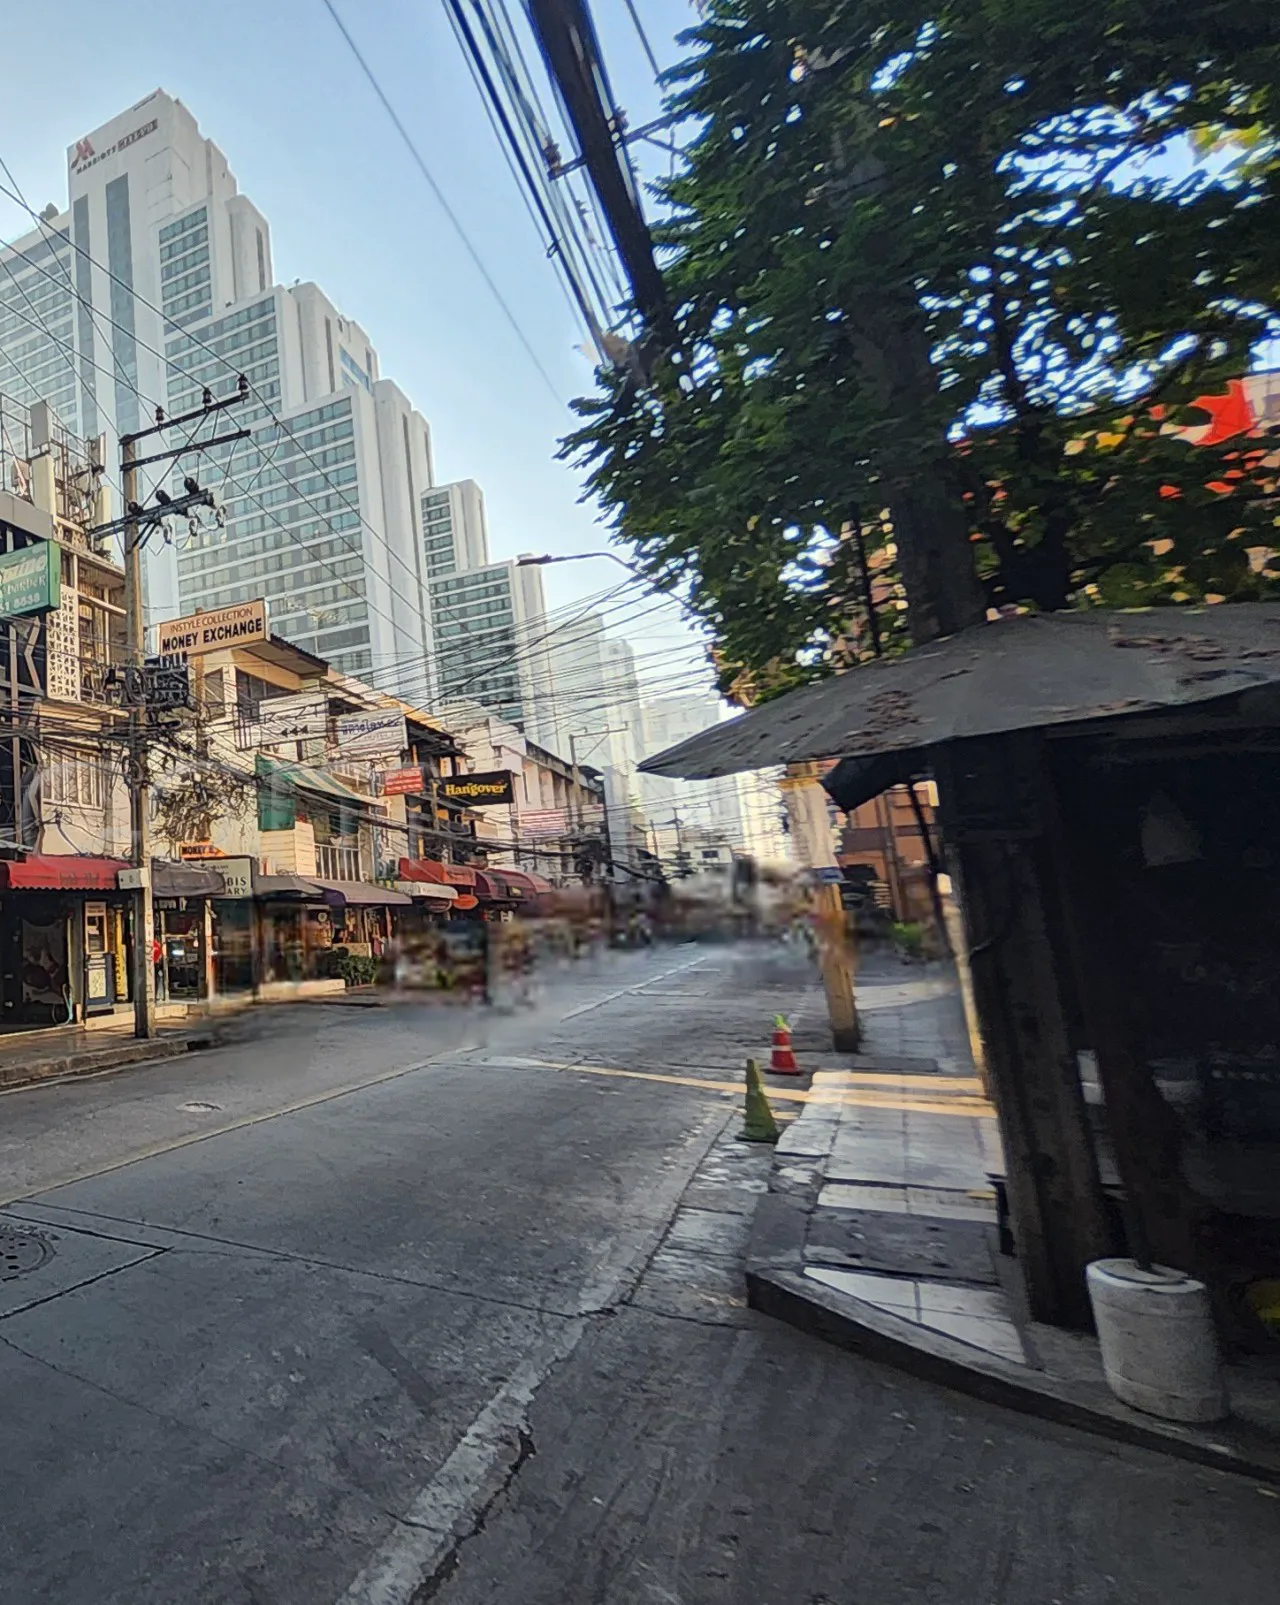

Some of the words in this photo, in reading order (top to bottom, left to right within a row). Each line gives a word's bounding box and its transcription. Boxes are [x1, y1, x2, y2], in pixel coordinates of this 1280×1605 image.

[76, 145, 117, 175] MARRIOTT
[170, 619, 201, 634] INSTYLE
[202, 606, 253, 627] COLLECTION
[162, 631, 198, 653] MONEY
[203, 617, 263, 644] EXCHANGE
[445, 782, 507, 797] Hangover
